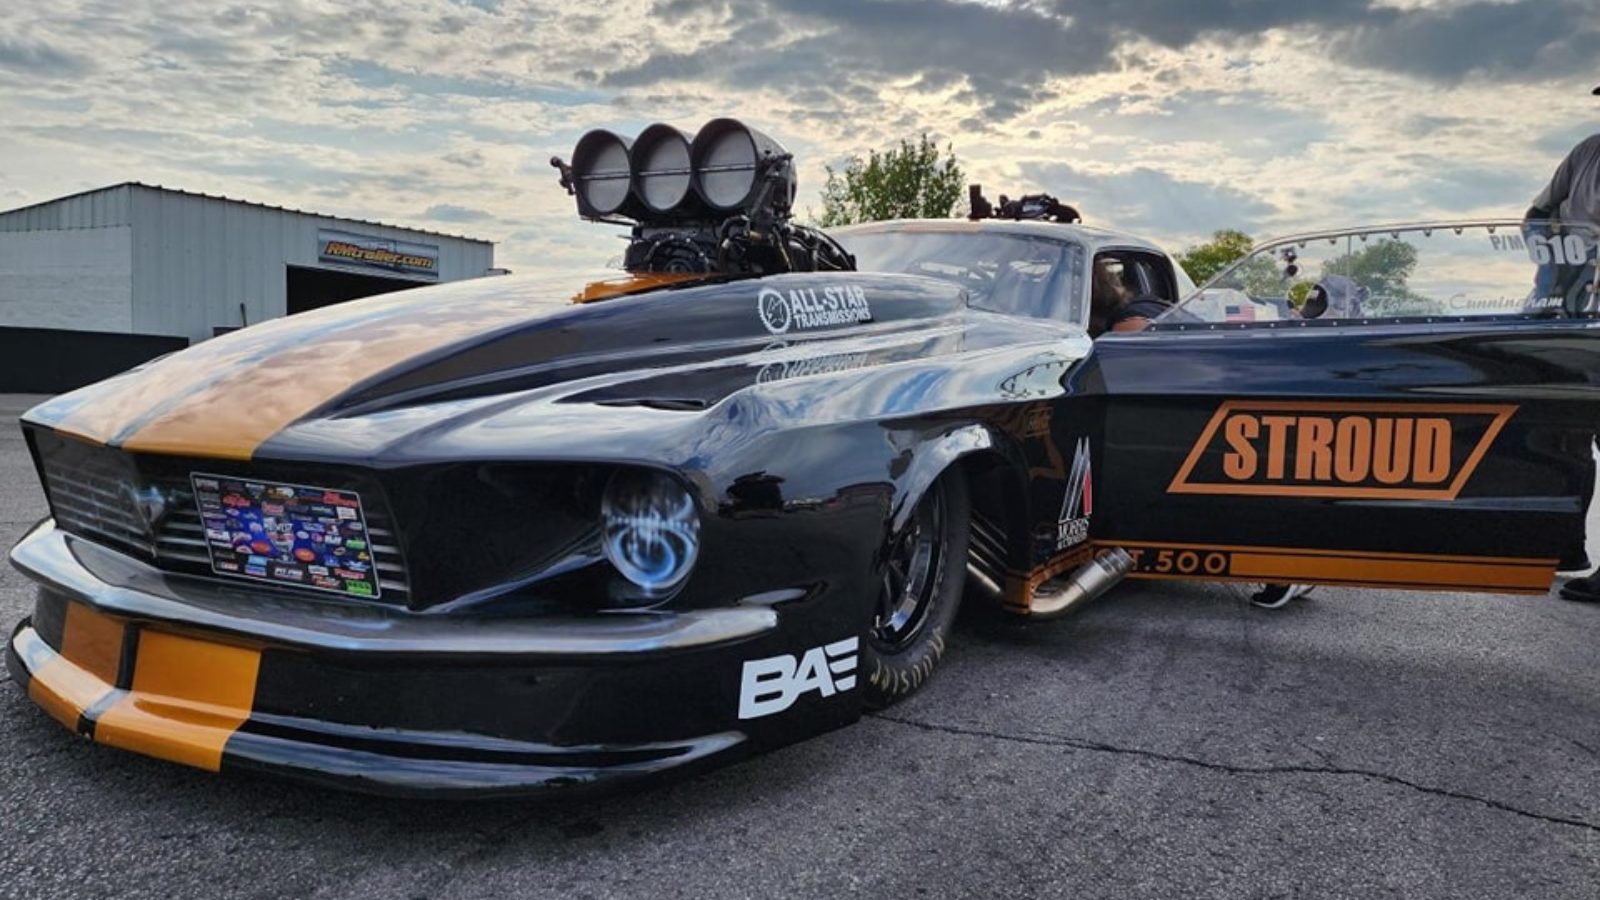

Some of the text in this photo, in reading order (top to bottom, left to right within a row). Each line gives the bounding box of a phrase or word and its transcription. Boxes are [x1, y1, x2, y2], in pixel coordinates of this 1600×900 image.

[1527, 234, 1588, 266] 610
[793, 308, 871, 328] TRANSMISSIONS
[1223, 414, 1452, 484] STROUD
[738, 636, 859, 719] BAE
